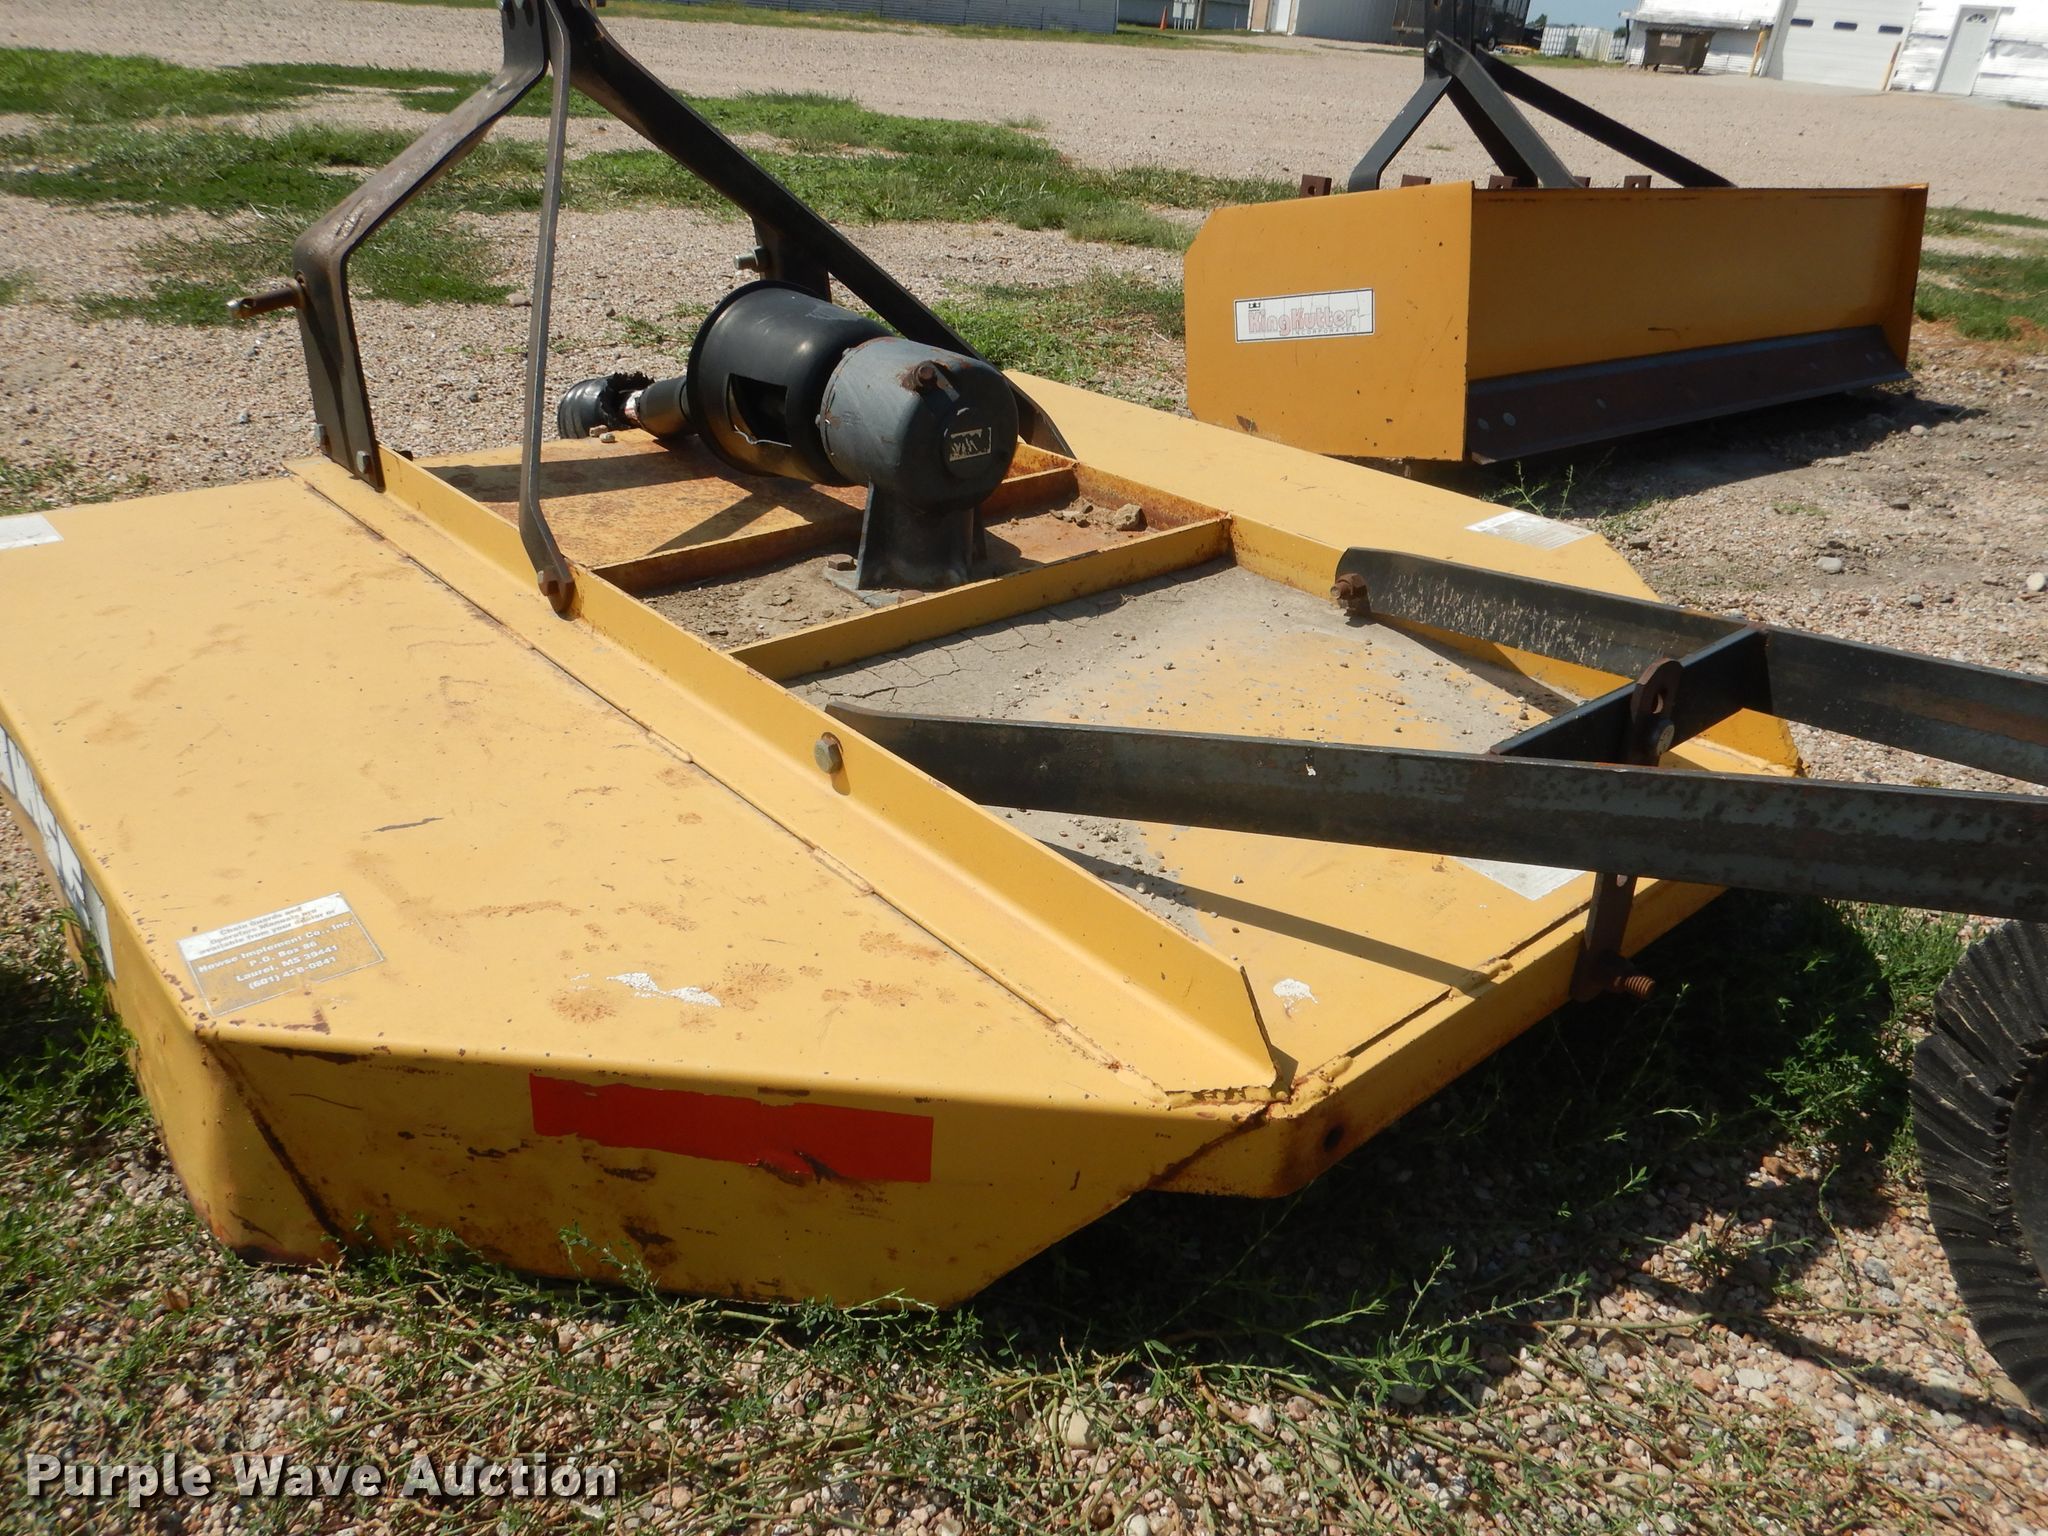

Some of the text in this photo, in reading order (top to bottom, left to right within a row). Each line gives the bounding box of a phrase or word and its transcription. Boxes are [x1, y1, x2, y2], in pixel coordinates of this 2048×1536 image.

[1291, 326, 1357, 335] INCORPORATED
[241, 936, 303, 958] Implement
[278, 947, 299, 957] Box
[281, 957, 301, 967] MS
